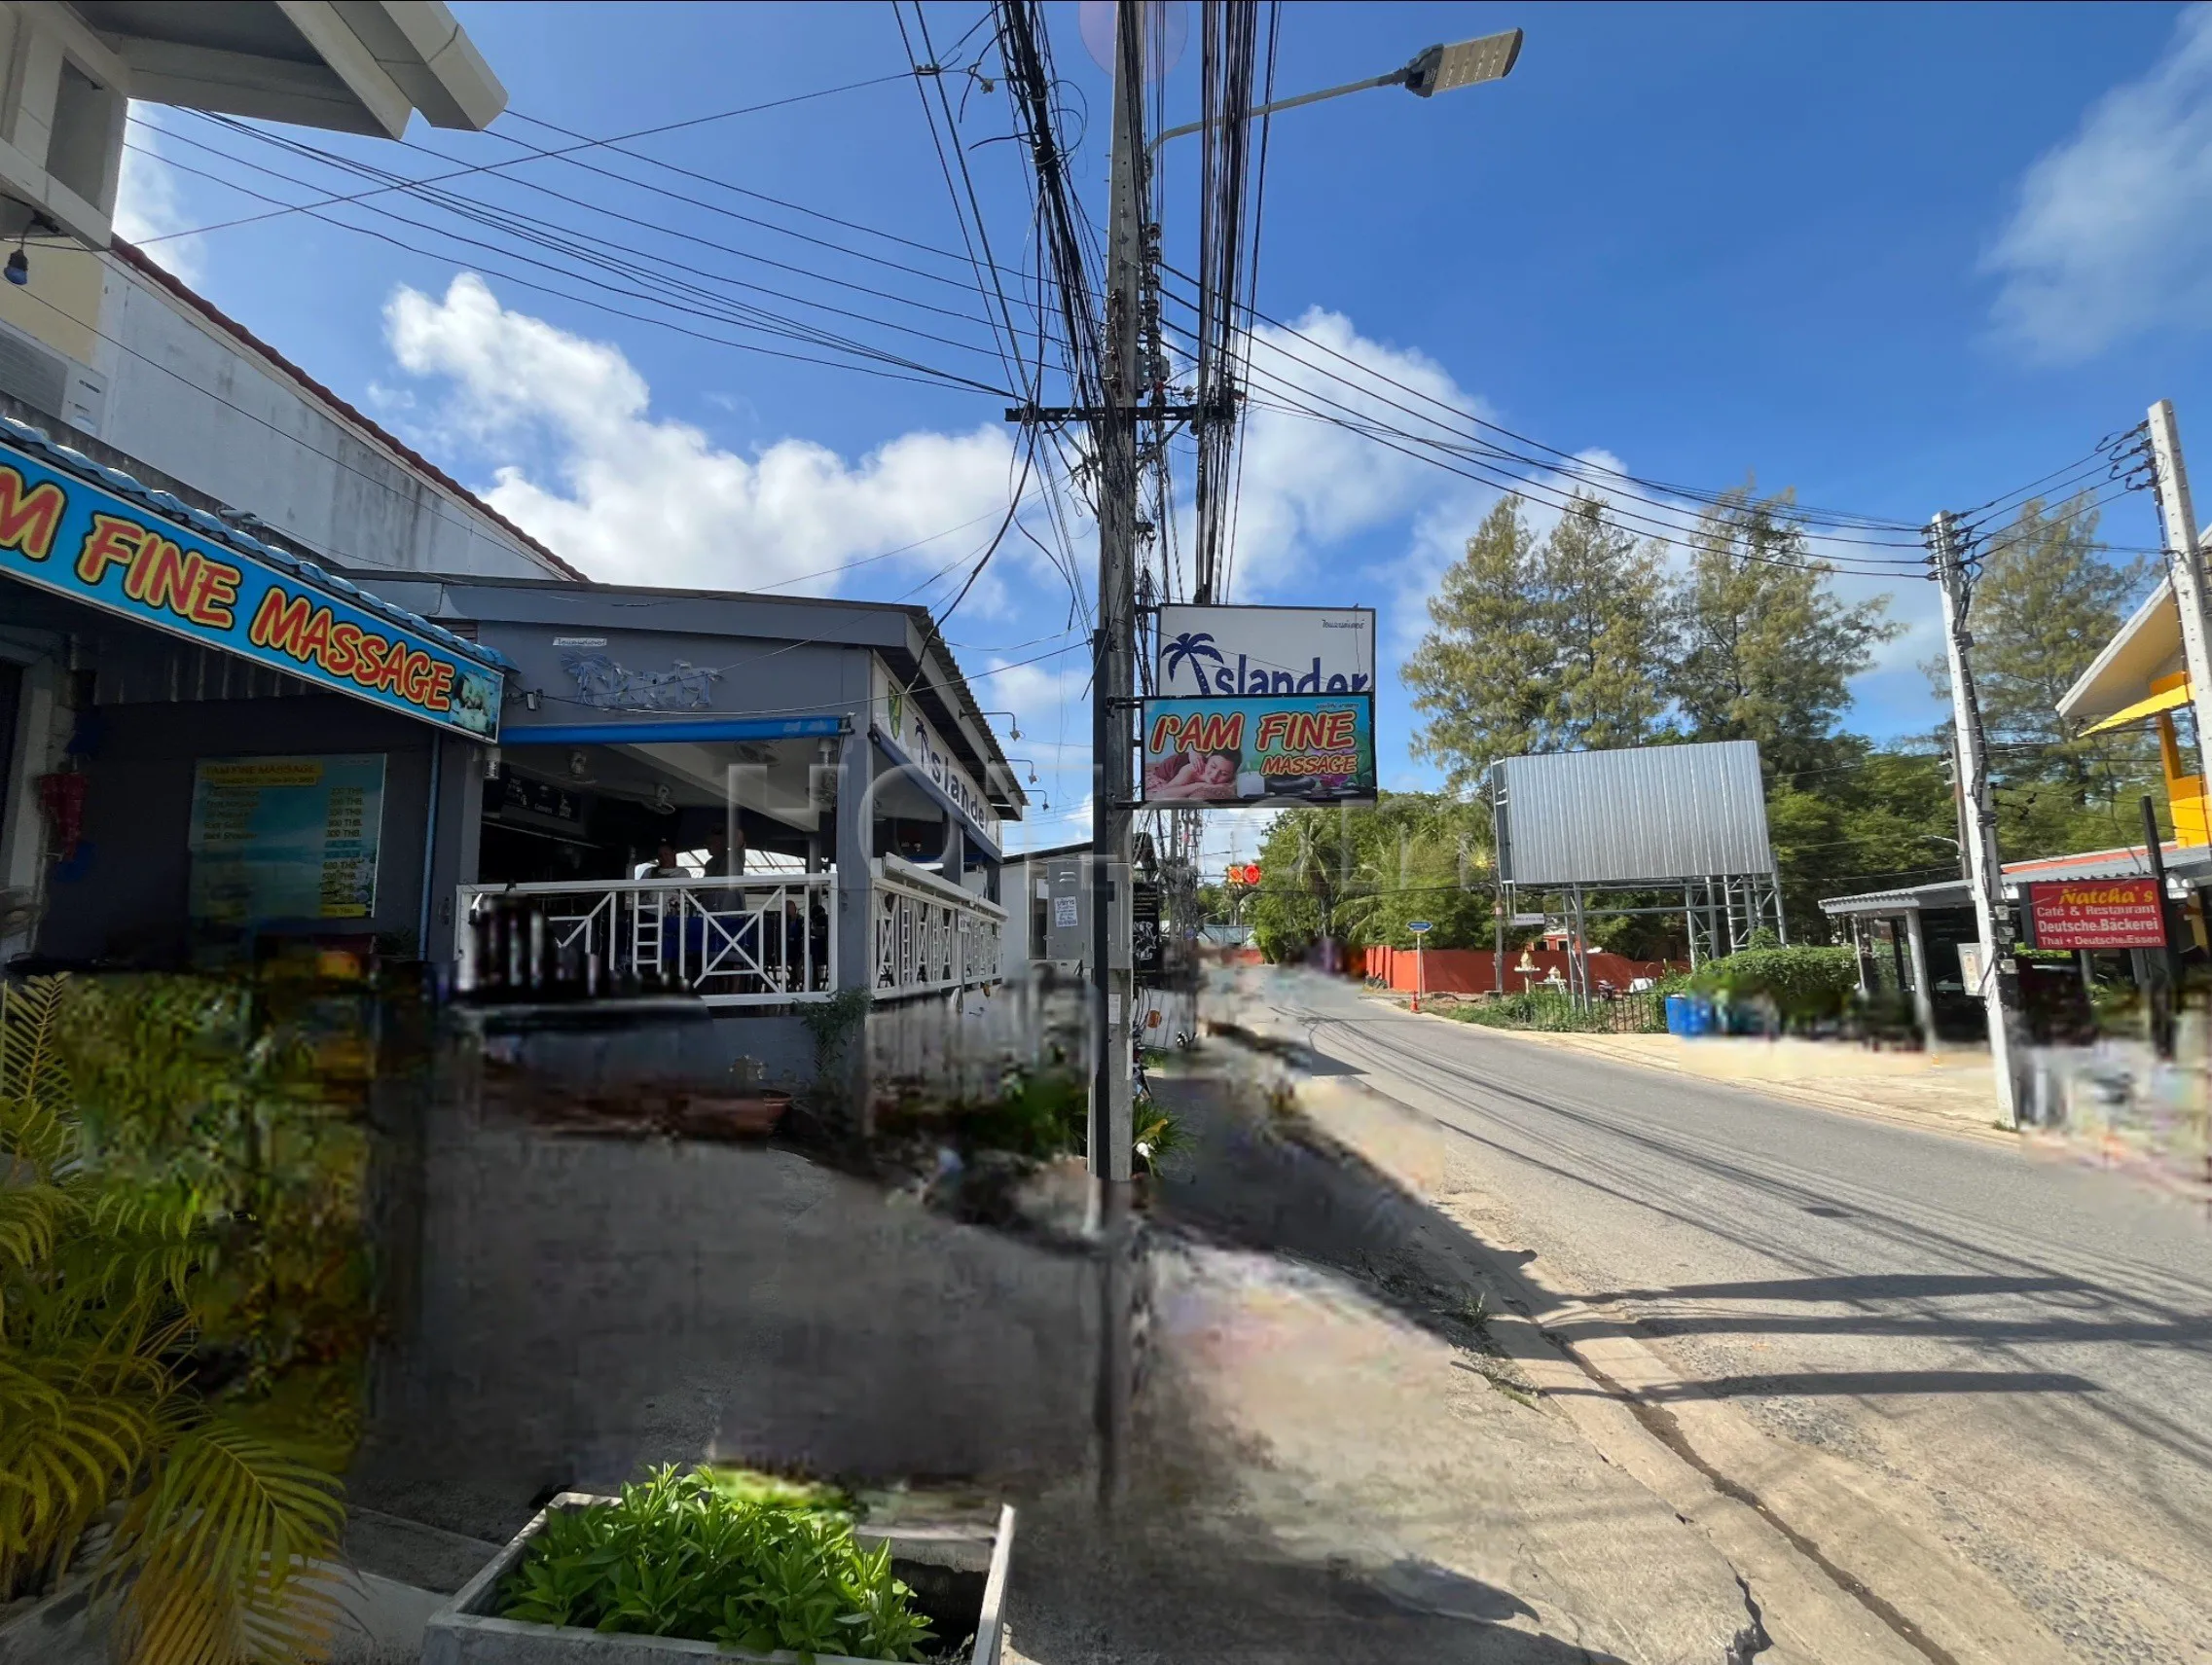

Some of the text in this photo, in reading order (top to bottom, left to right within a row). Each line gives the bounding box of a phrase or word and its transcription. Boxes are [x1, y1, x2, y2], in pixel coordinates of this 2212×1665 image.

[74, 509, 242, 631] FINE
[247, 586, 456, 713] MASSAGE
[1254, 709, 1357, 751] FINE
[1260, 753, 1359, 777] MASSAGE
[2070, 906, 2081, 916] &
[2085, 904, 2156, 916] Restaurant
[2041, 936, 2063, 946] Thai
[2125, 934, 2161, 944] Essen
